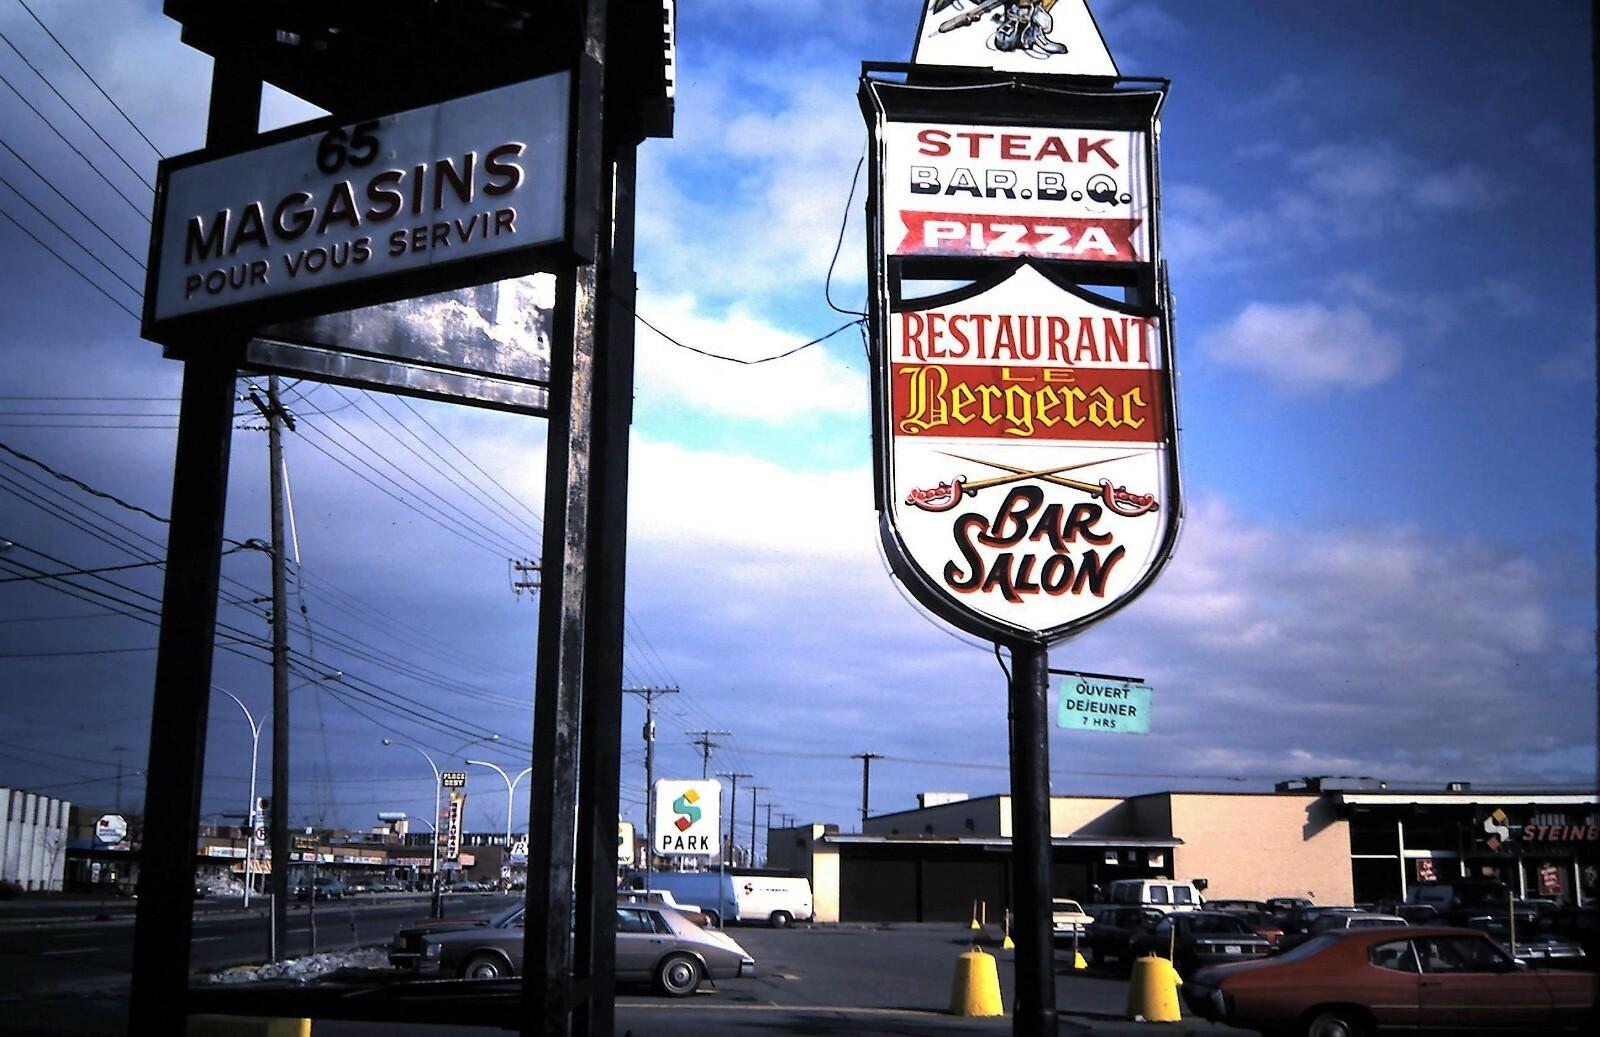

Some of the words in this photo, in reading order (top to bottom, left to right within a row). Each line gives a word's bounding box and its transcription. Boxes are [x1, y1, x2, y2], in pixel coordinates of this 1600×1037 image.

[316, 122, 380, 174] 65
[917, 129, 1119, 169] STEAK
[184, 142, 526, 266] MAGASINS
[185, 260, 270, 299] POUR
[284, 236, 372, 278] VOUS
[388, 207, 518, 257] SERVIR
[923, 220, 1119, 255] PIZZA
[901, 312, 1155, 365] RESTAURANT
[898, 364, 1147, 437] Bergerac
[1001, 367, 1076, 382] LE
[977, 485, 1113, 553] BAR
[944, 512, 1126, 604] SALON
[1066, 699, 1137, 717] DEJEUNER
[1076, 683, 1131, 699] OUVERT
[1082, 717, 1088, 725] 7
[1093, 718, 1117, 728] HRS
[449, 802, 458, 857] RESTAURANT
[663, 835, 709, 850] PARK
